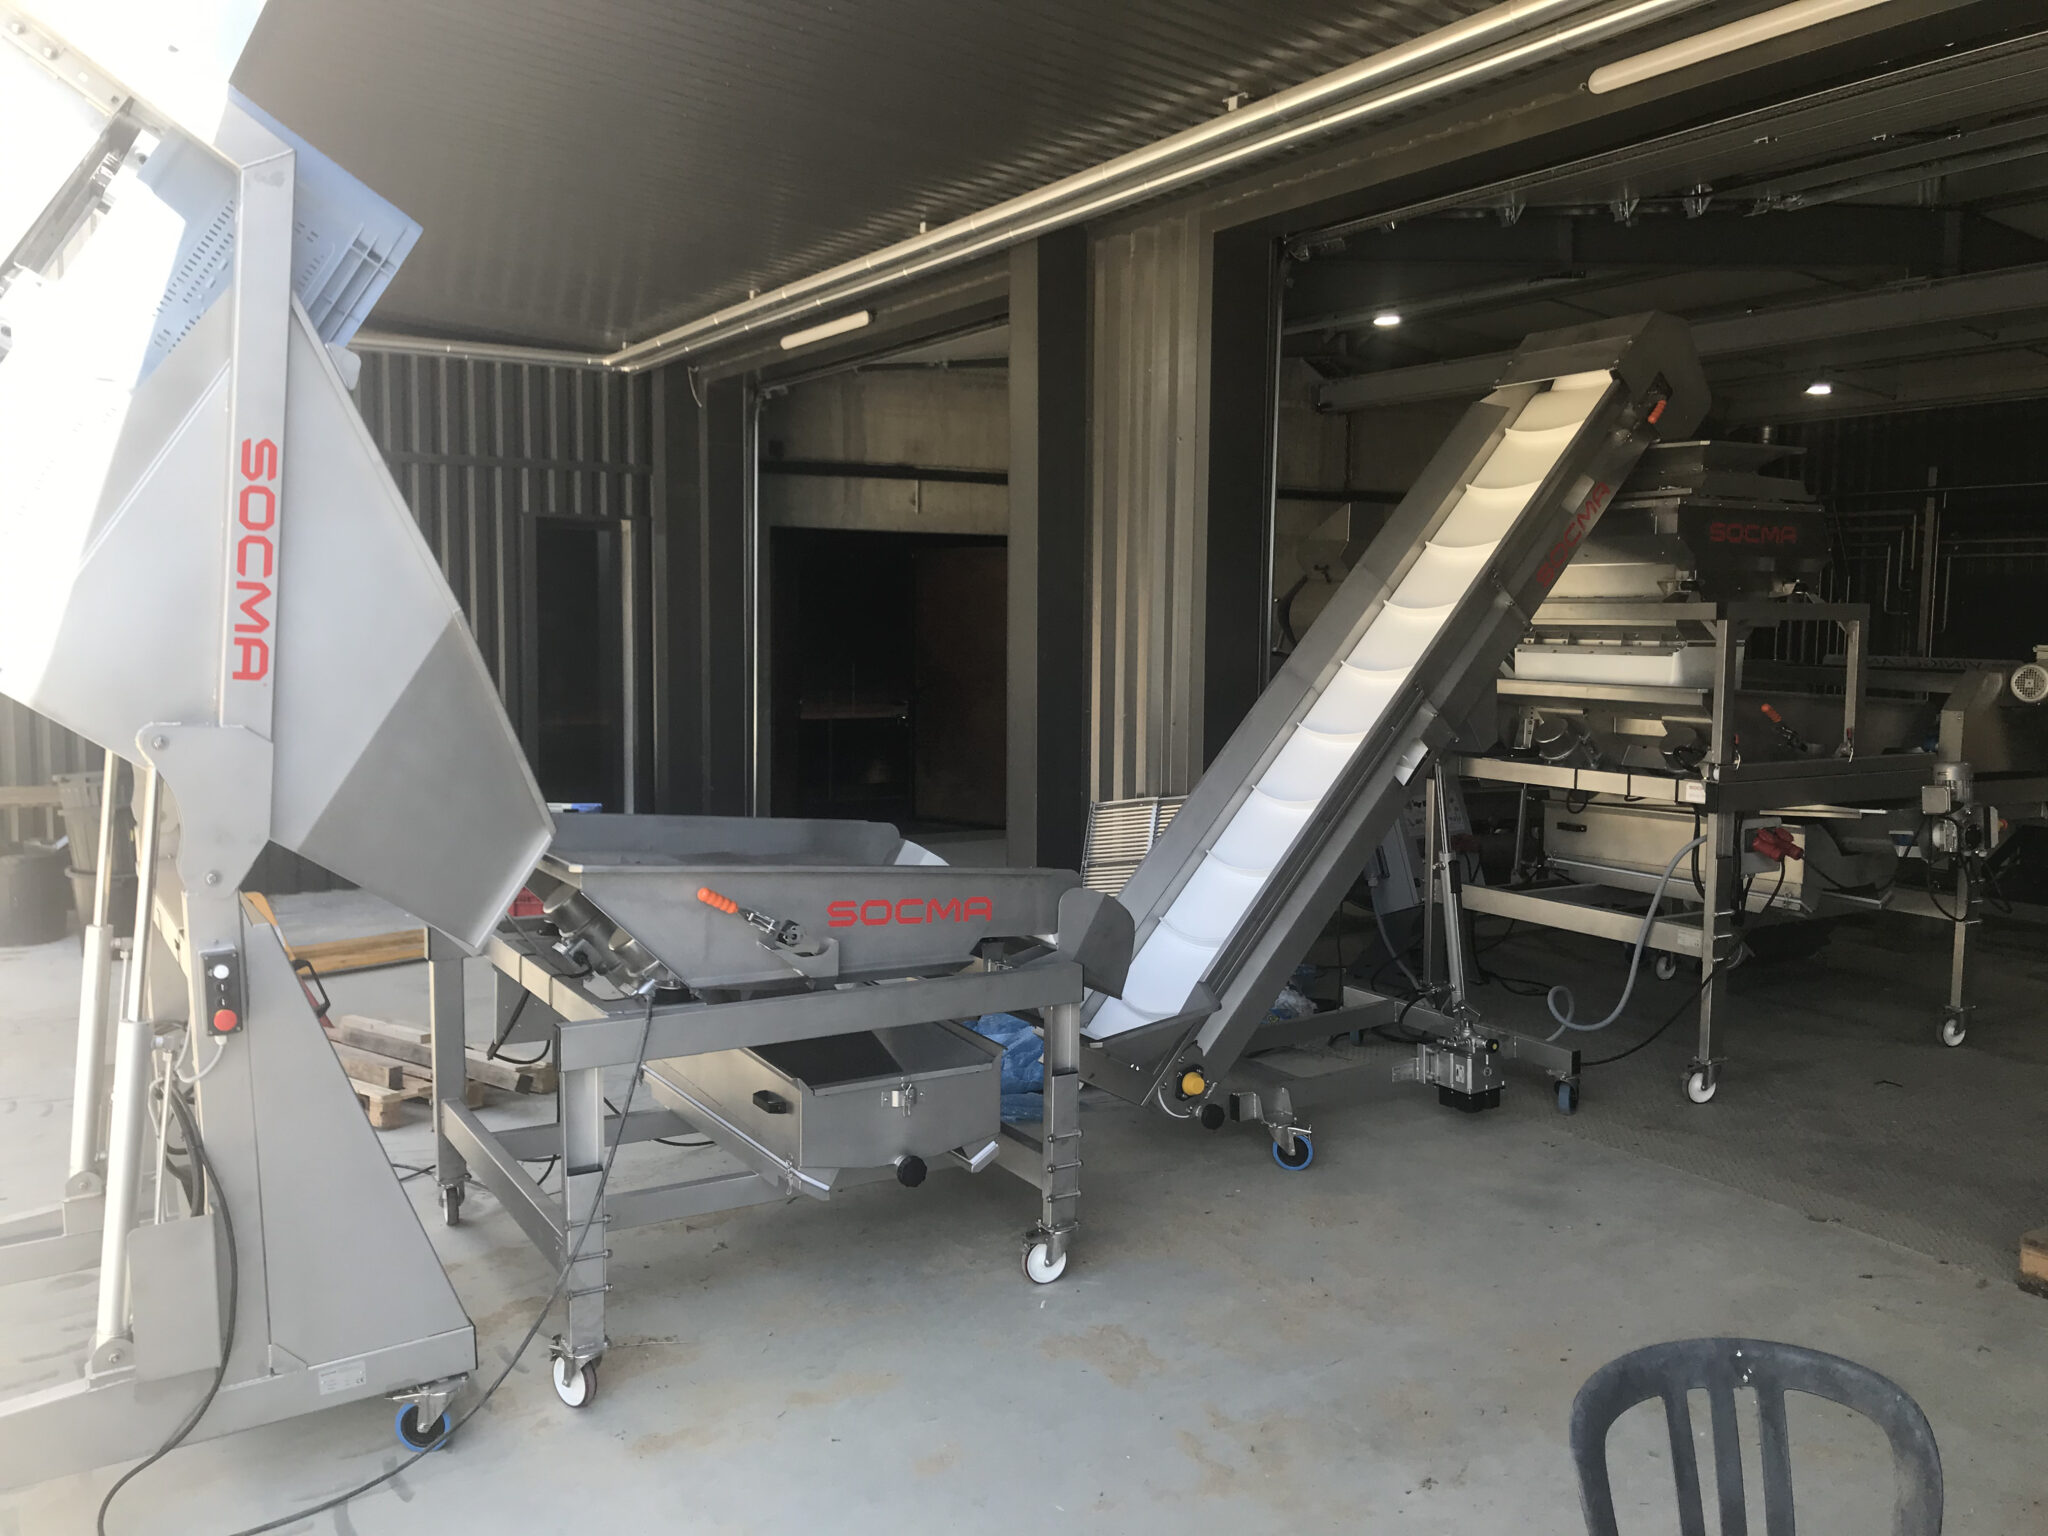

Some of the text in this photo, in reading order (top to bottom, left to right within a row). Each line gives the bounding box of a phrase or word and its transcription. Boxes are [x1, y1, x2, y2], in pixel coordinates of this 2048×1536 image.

[232, 438, 278, 681] SOCMA
[1536, 481, 1611, 587] SOCMA
[1709, 522, 1798, 544] SOCMA
[826, 896, 993, 927] SOCMA
